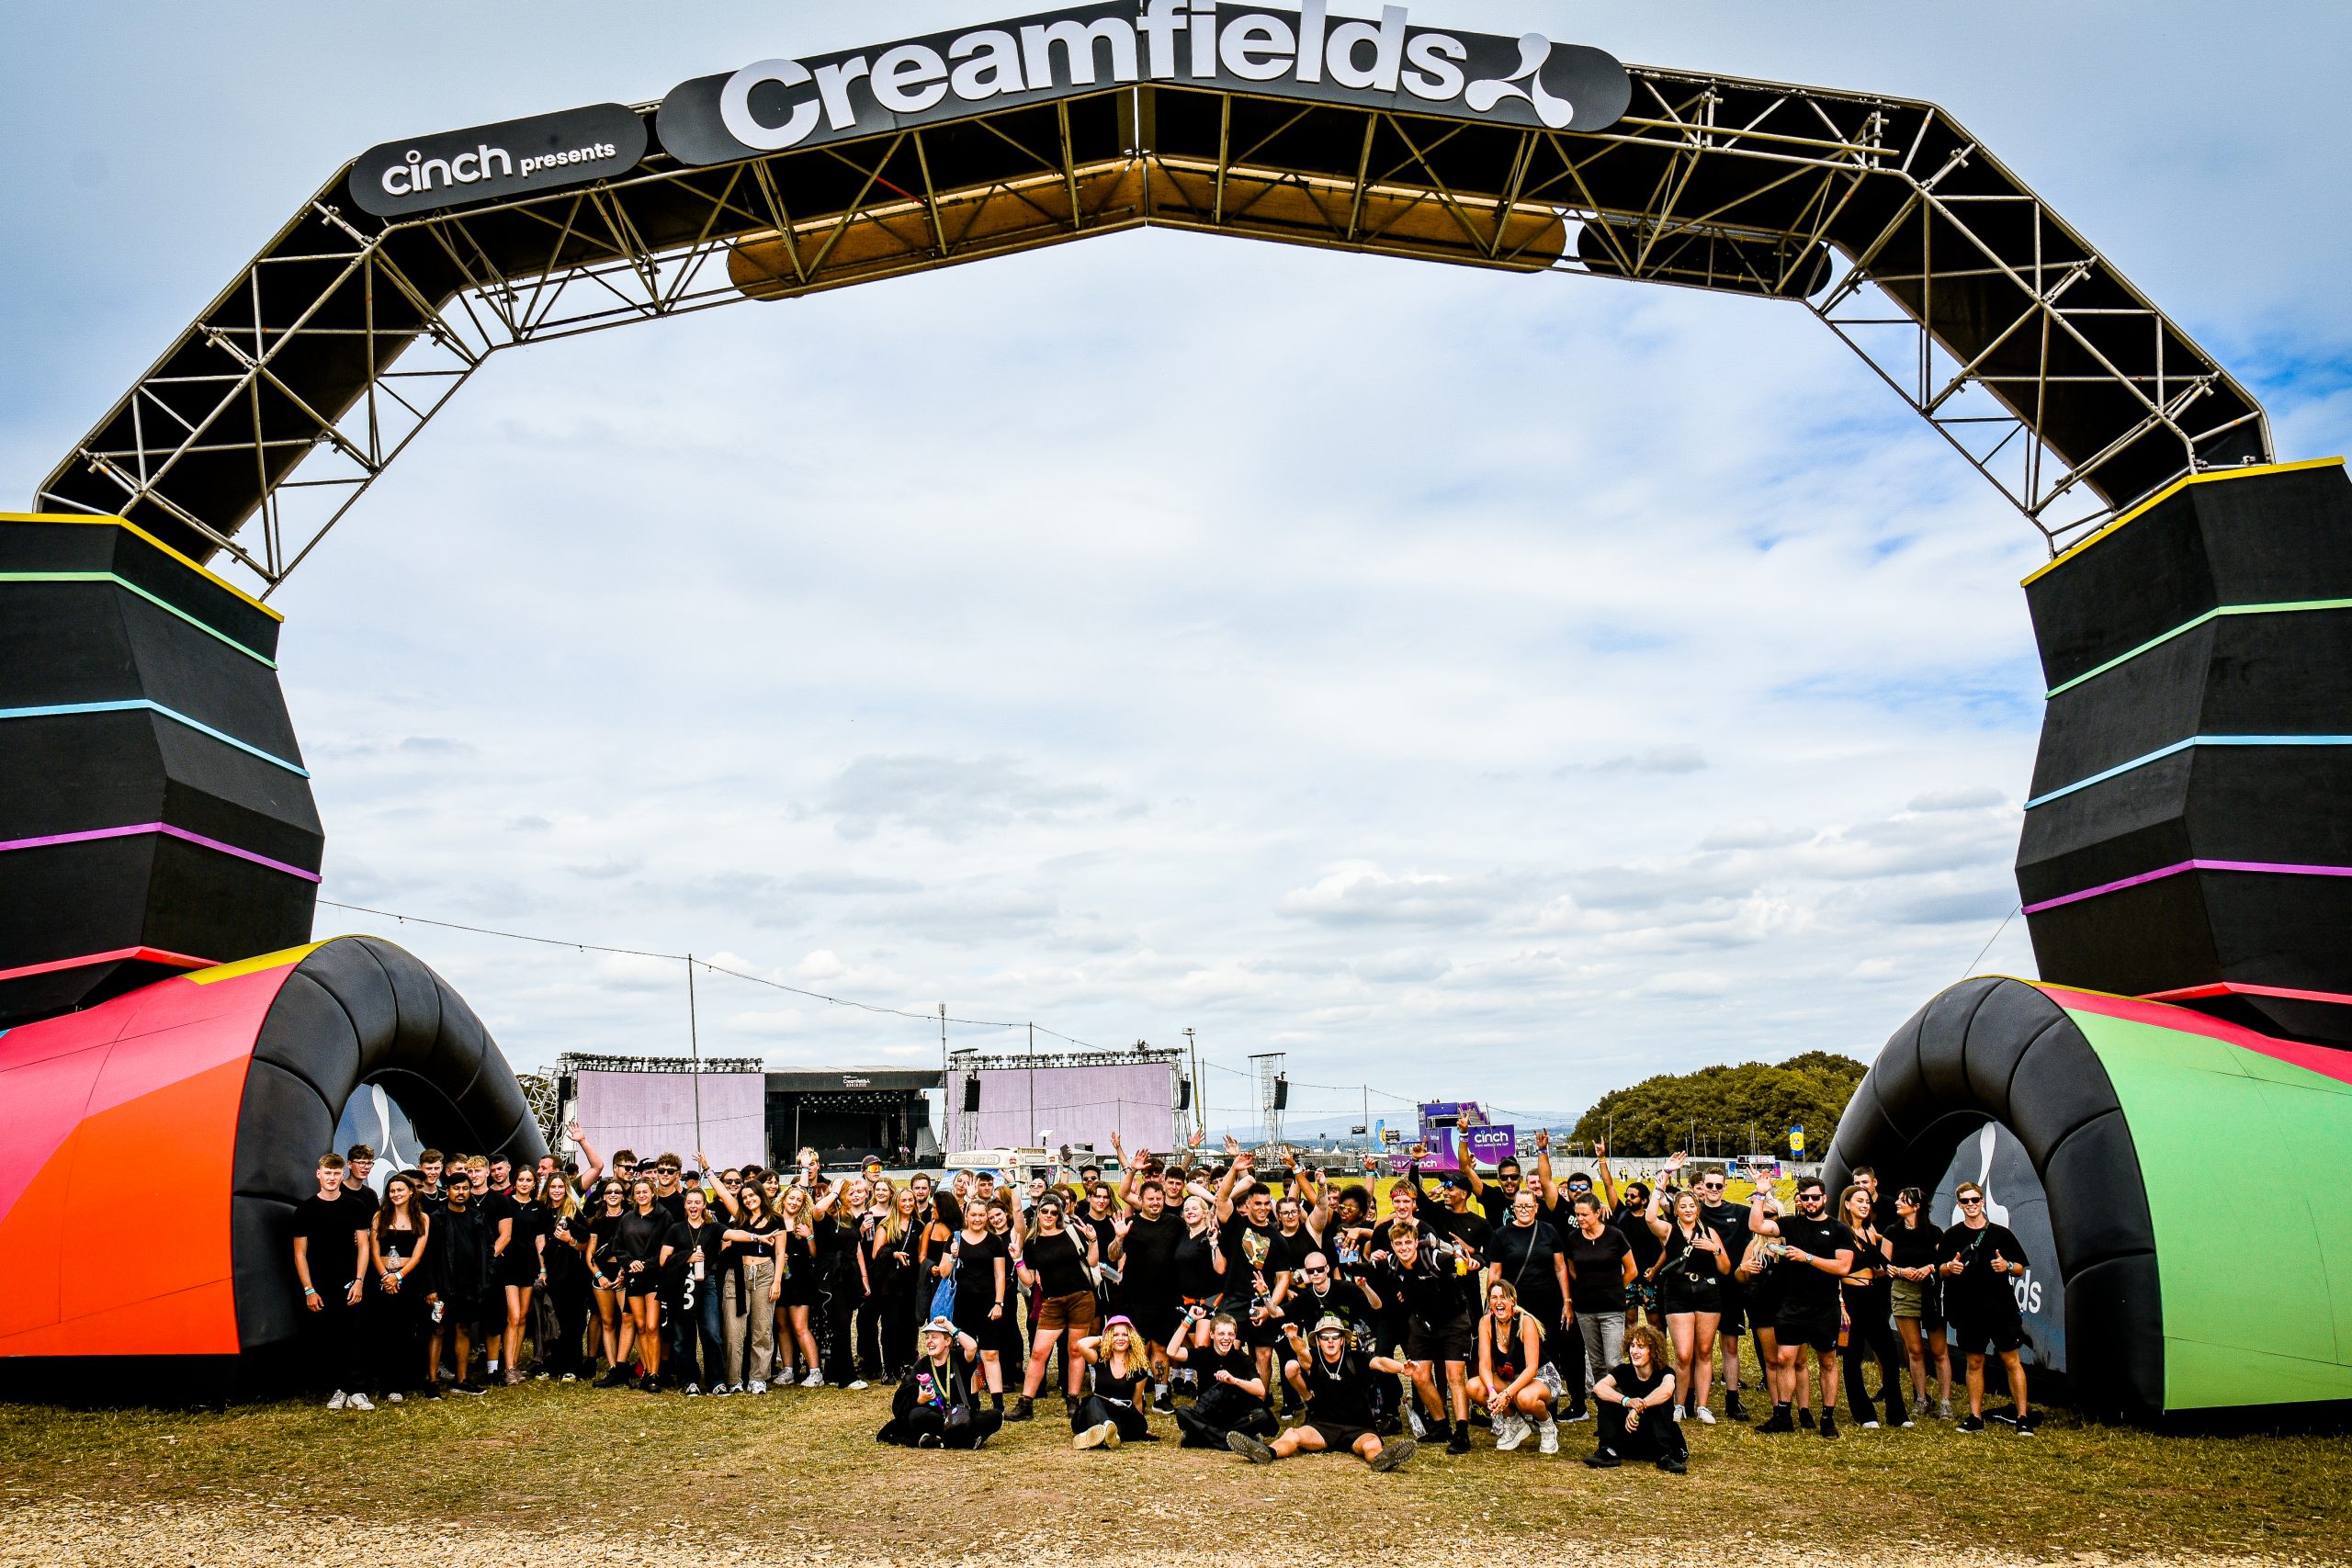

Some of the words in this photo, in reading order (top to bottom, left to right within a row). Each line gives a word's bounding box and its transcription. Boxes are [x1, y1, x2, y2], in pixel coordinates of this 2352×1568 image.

[719, 0, 1468, 151] Creamfields
[381, 144, 514, 197] cinch
[520, 141, 616, 177] presents
[1474, 1130, 1509, 1144] cinch
[1419, 1159, 1438, 1168] inch
